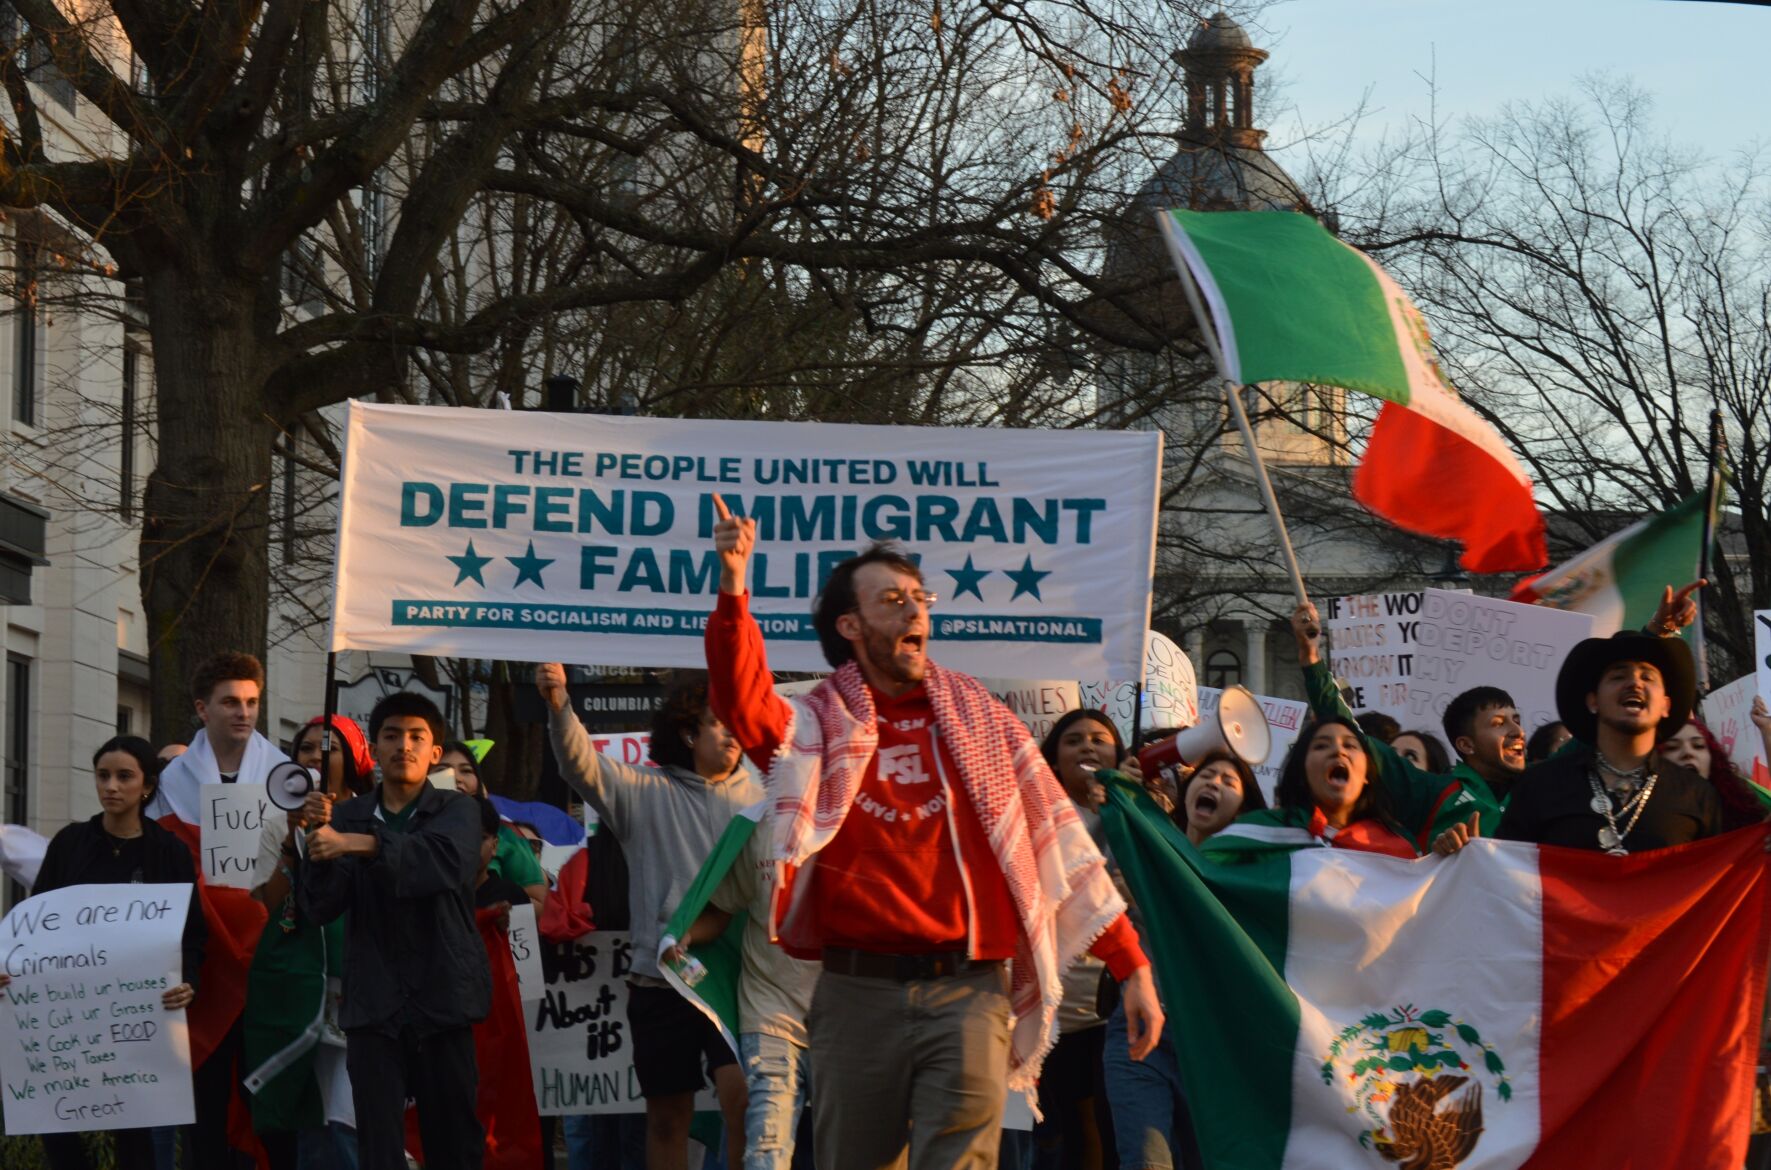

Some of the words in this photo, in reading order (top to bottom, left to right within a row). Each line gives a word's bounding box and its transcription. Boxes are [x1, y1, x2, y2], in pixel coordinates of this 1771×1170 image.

[508, 450, 584, 477] THE
[596, 453, 742, 483] PEOPLE
[754, 458, 898, 485] UNITED
[907, 461, 999, 486] WILL
[401, 482, 675, 536] DEFEND
[698, 493, 1106, 545] IMMIGRANT
[406, 605, 470, 621] PARTY
[476, 607, 514, 622] FOR
[520, 608, 627, 626] SOCIALISM
[633, 613, 674, 629] AND
[940, 618, 1088, 638] @PSLNATIONAL
[1328, 598, 1341, 619] IF
[1345, 594, 1380, 617] THE
[1422, 593, 1518, 637] DONT
[1417, 621, 1556, 670] DEPORT
[1398, 654, 1414, 676] IT
[583, 697, 651, 712] COLUMBIA
[211, 797, 271, 831] Fuck
[11, 902, 61, 938] We
[76, 904, 120, 927] are
[125, 899, 172, 922] not
[5, 943, 108, 978] Criminals
[6, 985, 40, 1006] We
[48, 982, 87, 1001] build
[94, 983, 114, 996] ur
[119, 976, 168, 993] houses
[14, 1012, 40, 1031] We
[82, 1007, 101, 1020] ur
[111, 1001, 155, 1019] Grass
[535, 984, 617, 1033] About
[20, 1039, 42, 1054] We
[47, 1035, 80, 1053] Cook
[87, 1033, 102, 1046] ur
[110, 1020, 158, 1041] FOOD
[26, 1057, 47, 1073] We
[53, 1056, 77, 1073] Pay
[8, 1082, 37, 1102] We
[44, 1075, 91, 1097] make
[101, 1070, 159, 1088] America
[541, 1067, 620, 1110] HUMAN
[54, 1094, 126, 1121] Great
